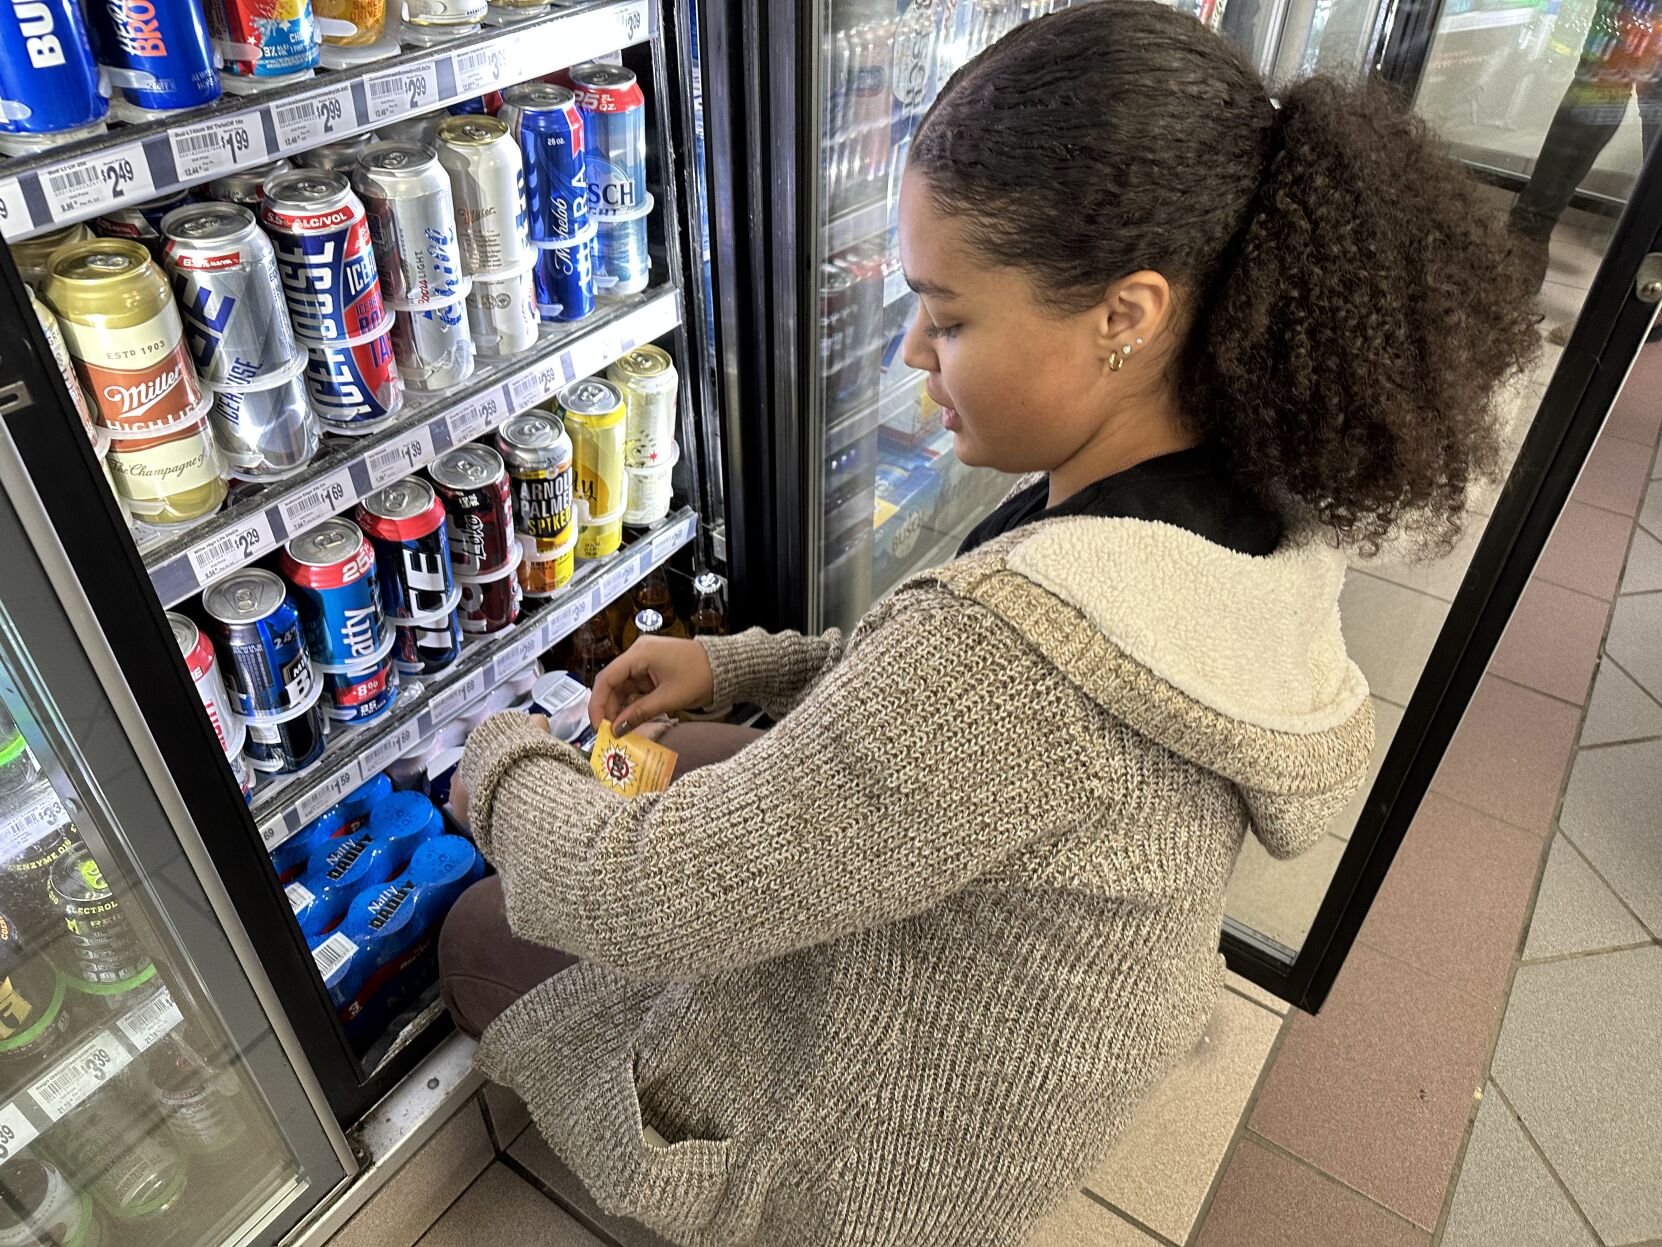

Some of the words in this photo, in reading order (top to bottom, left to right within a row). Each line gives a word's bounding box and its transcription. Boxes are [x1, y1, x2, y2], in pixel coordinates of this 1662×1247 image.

[12, 0, 66, 68] BU
[405, 76, 426, 109] $299
[317, 98, 341, 133] $299
[221, 128, 249, 164] $199
[101, 160, 134, 199] $249
[587, 180, 634, 206] SCH
[551, 197, 573, 276] Mchelob
[273, 238, 373, 419] ICEHOUSE
[141, 340, 165, 354] 1903
[104, 363, 183, 418] Miller
[129, 457, 197, 480] Champagne
[401, 440, 422, 468] $139
[321, 483, 344, 511] $169
[521, 471, 572, 500] ARNOL
[521, 491, 572, 520] PALME
[234, 528, 260, 559] $229
[342, 545, 371, 583] 25
[402, 549, 453, 649] ICE
[39, 801, 62, 826] $33
[326, 838, 356, 866] Natty
[367, 885, 398, 914] Natty
[81, 1048, 111, 1081] $339
